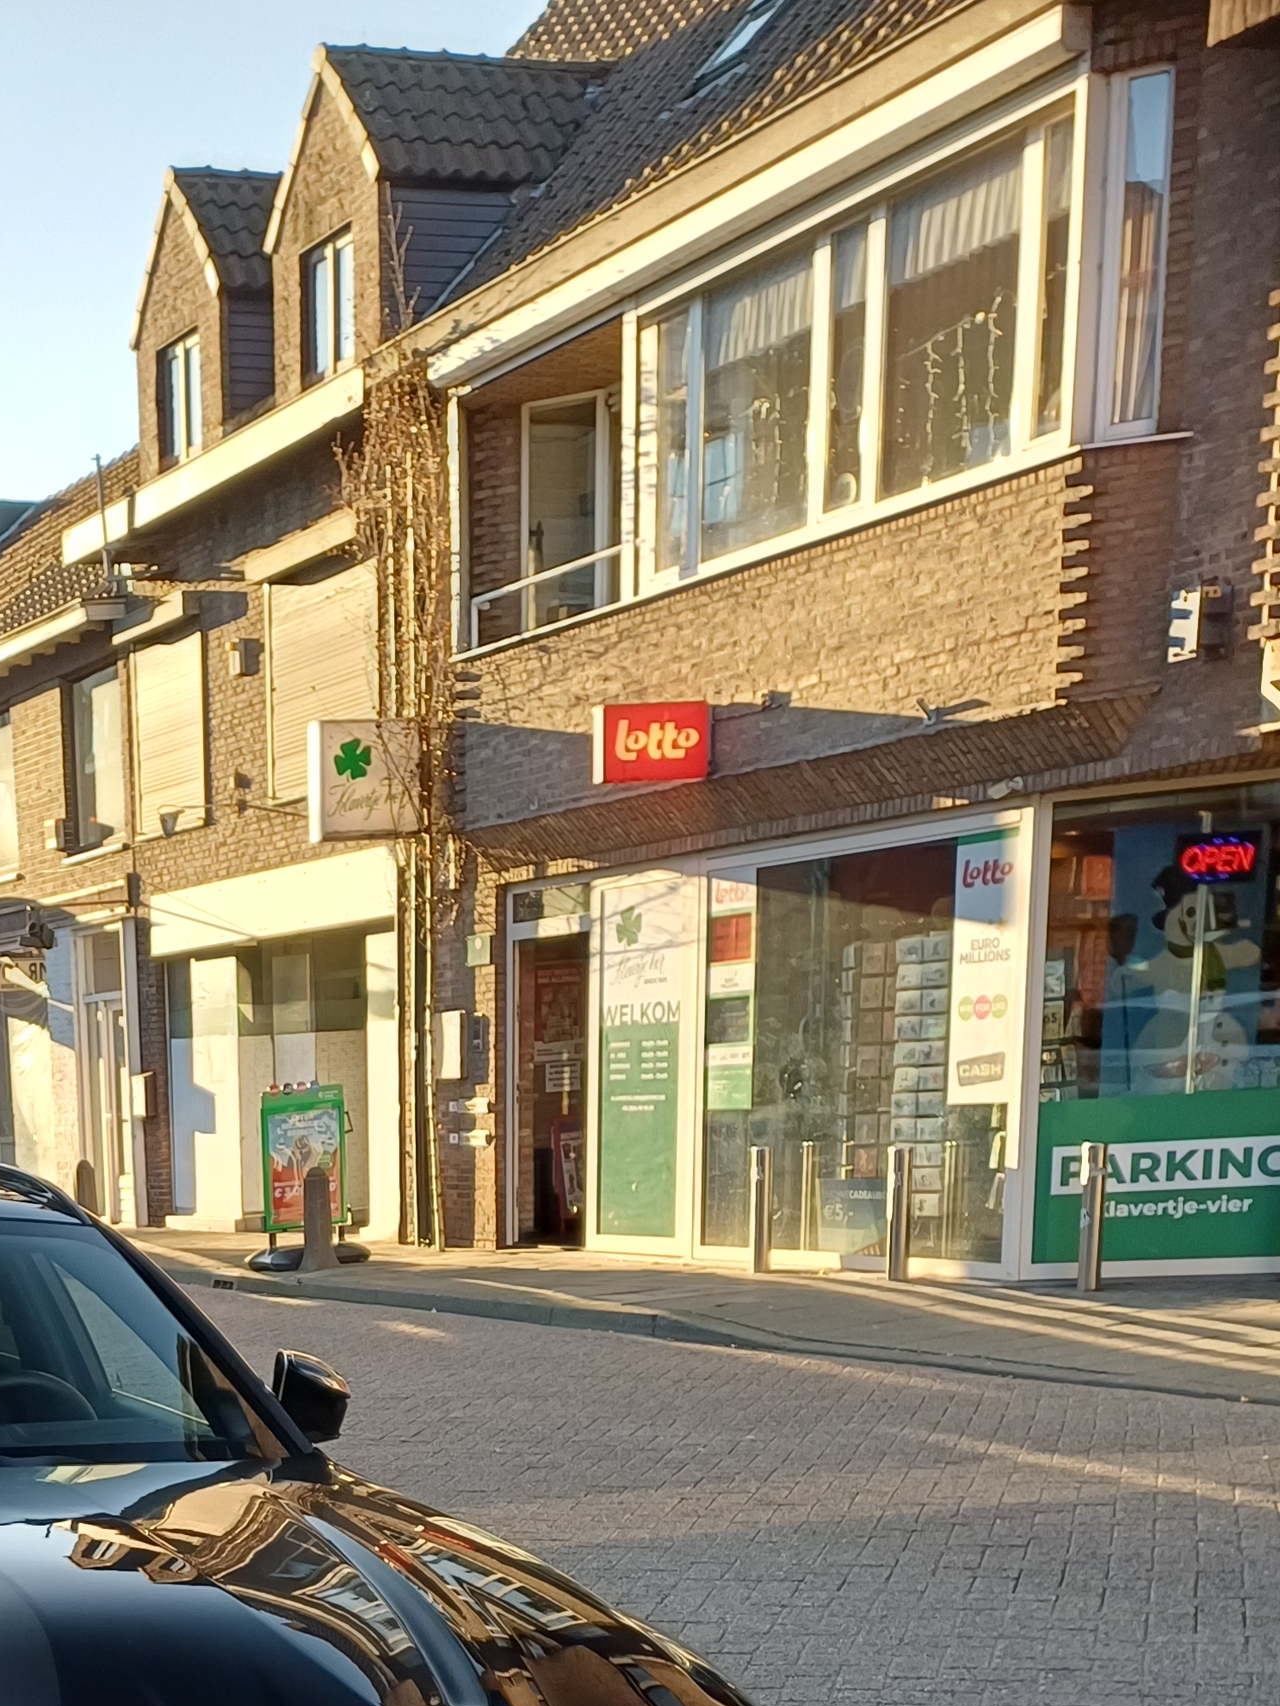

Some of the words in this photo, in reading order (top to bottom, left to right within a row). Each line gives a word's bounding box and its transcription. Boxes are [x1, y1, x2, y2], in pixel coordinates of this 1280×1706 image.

[1179, 845, 1255, 873] OPEN
[971, 937, 1000, 951] EURO
[959, 948, 1011, 965] MILLIONS
[604, 1000, 681, 1026] WELKOM
[959, 1063, 1001, 1077] CASH
